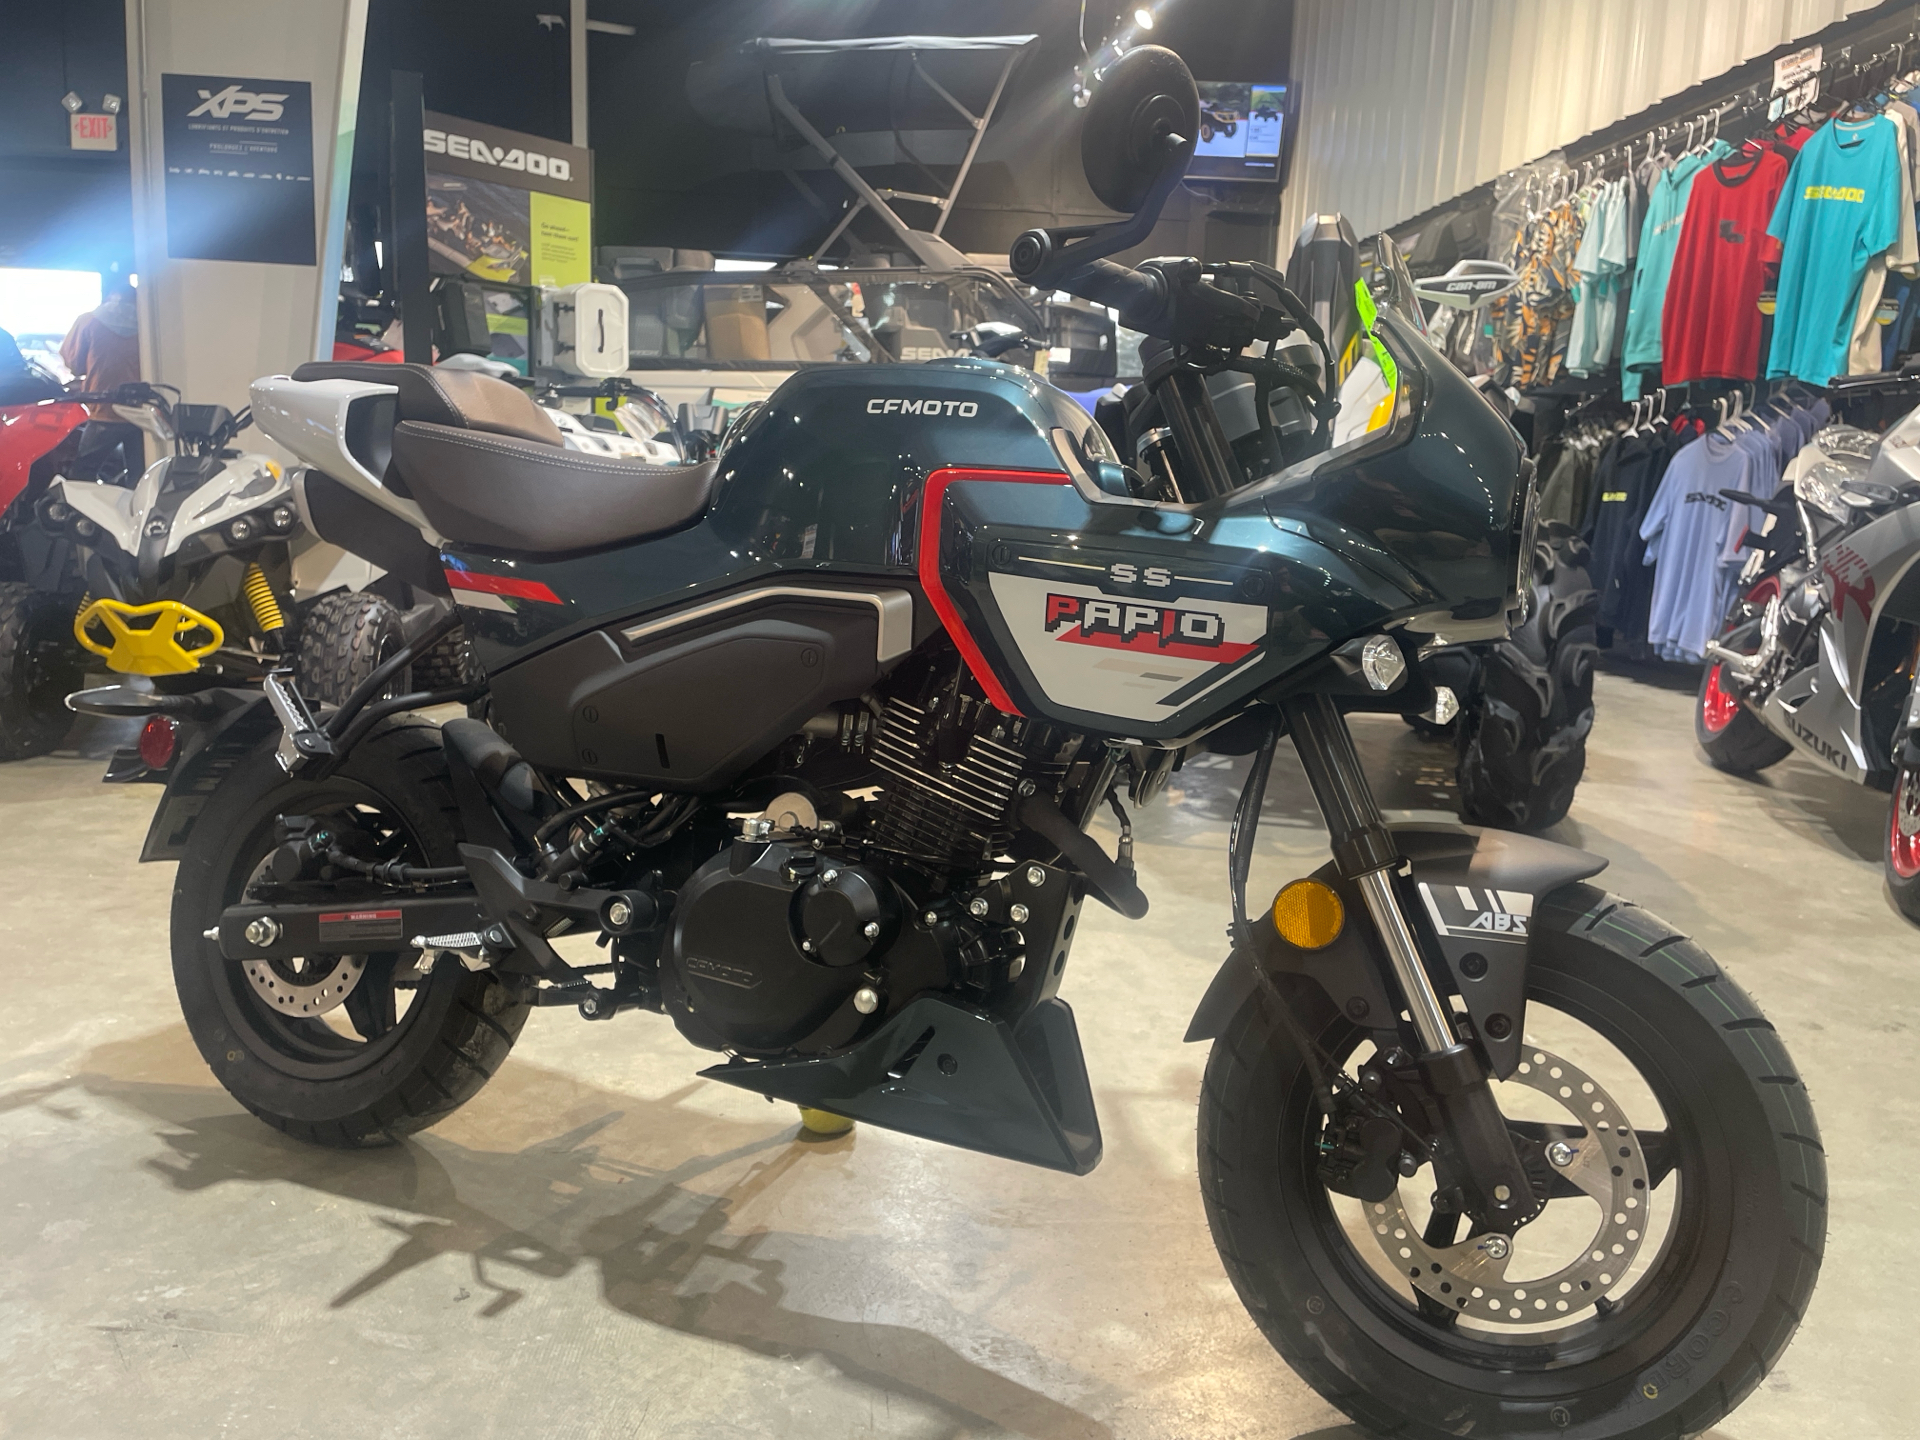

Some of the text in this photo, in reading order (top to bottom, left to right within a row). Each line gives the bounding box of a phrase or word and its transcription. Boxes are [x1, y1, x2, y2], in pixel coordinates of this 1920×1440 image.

[186, 85, 290, 121] XPS
[79, 116, 109, 139] EXIT
[866, 399, 979, 418] CFMOTO
[1045, 593, 1225, 648] PAPIO
[1784, 710, 1848, 772] SUZUKI
[1467, 911, 1527, 934] ABS
